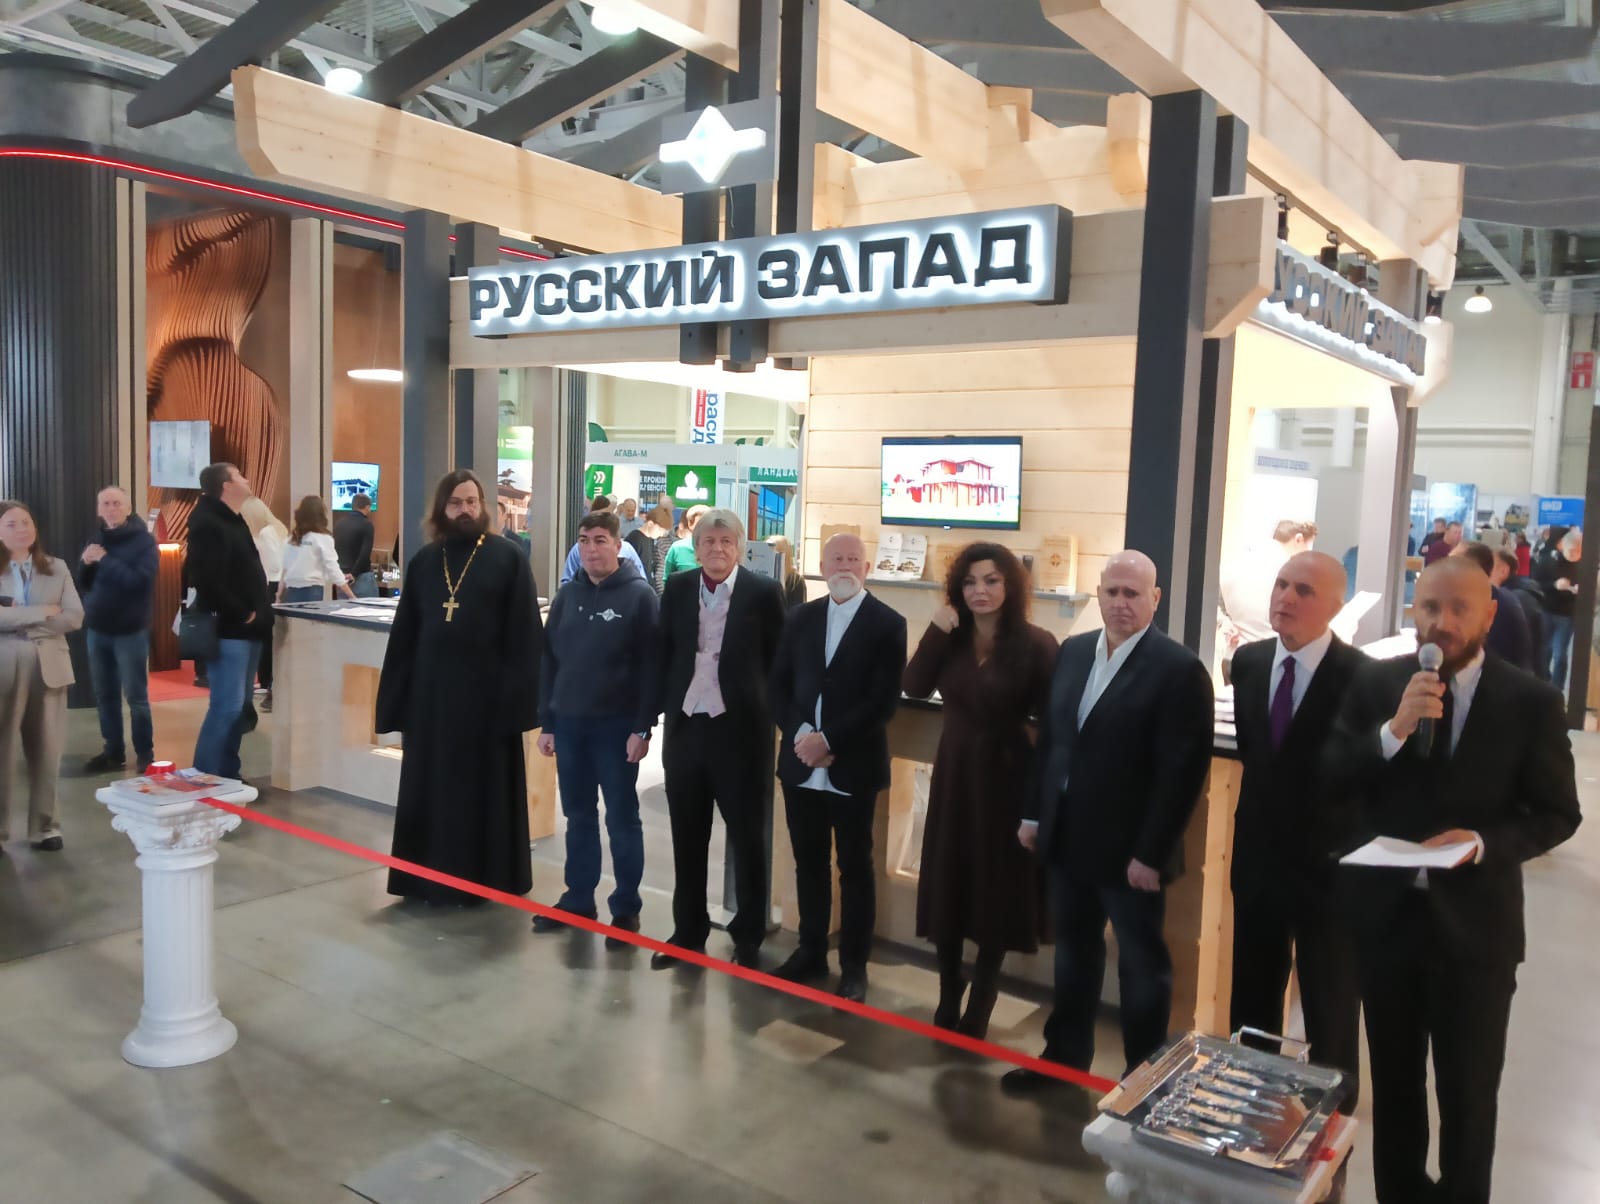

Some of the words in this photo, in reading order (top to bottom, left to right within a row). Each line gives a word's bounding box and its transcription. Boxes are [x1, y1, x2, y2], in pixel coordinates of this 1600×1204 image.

[469, 250, 735, 321] РУССКИЙ
[757, 224, 1032, 300] ЗАПАД
[1268, 248, 1369, 344] УССКИЙ
[614, 449, 648, 457] АГАВА-М
